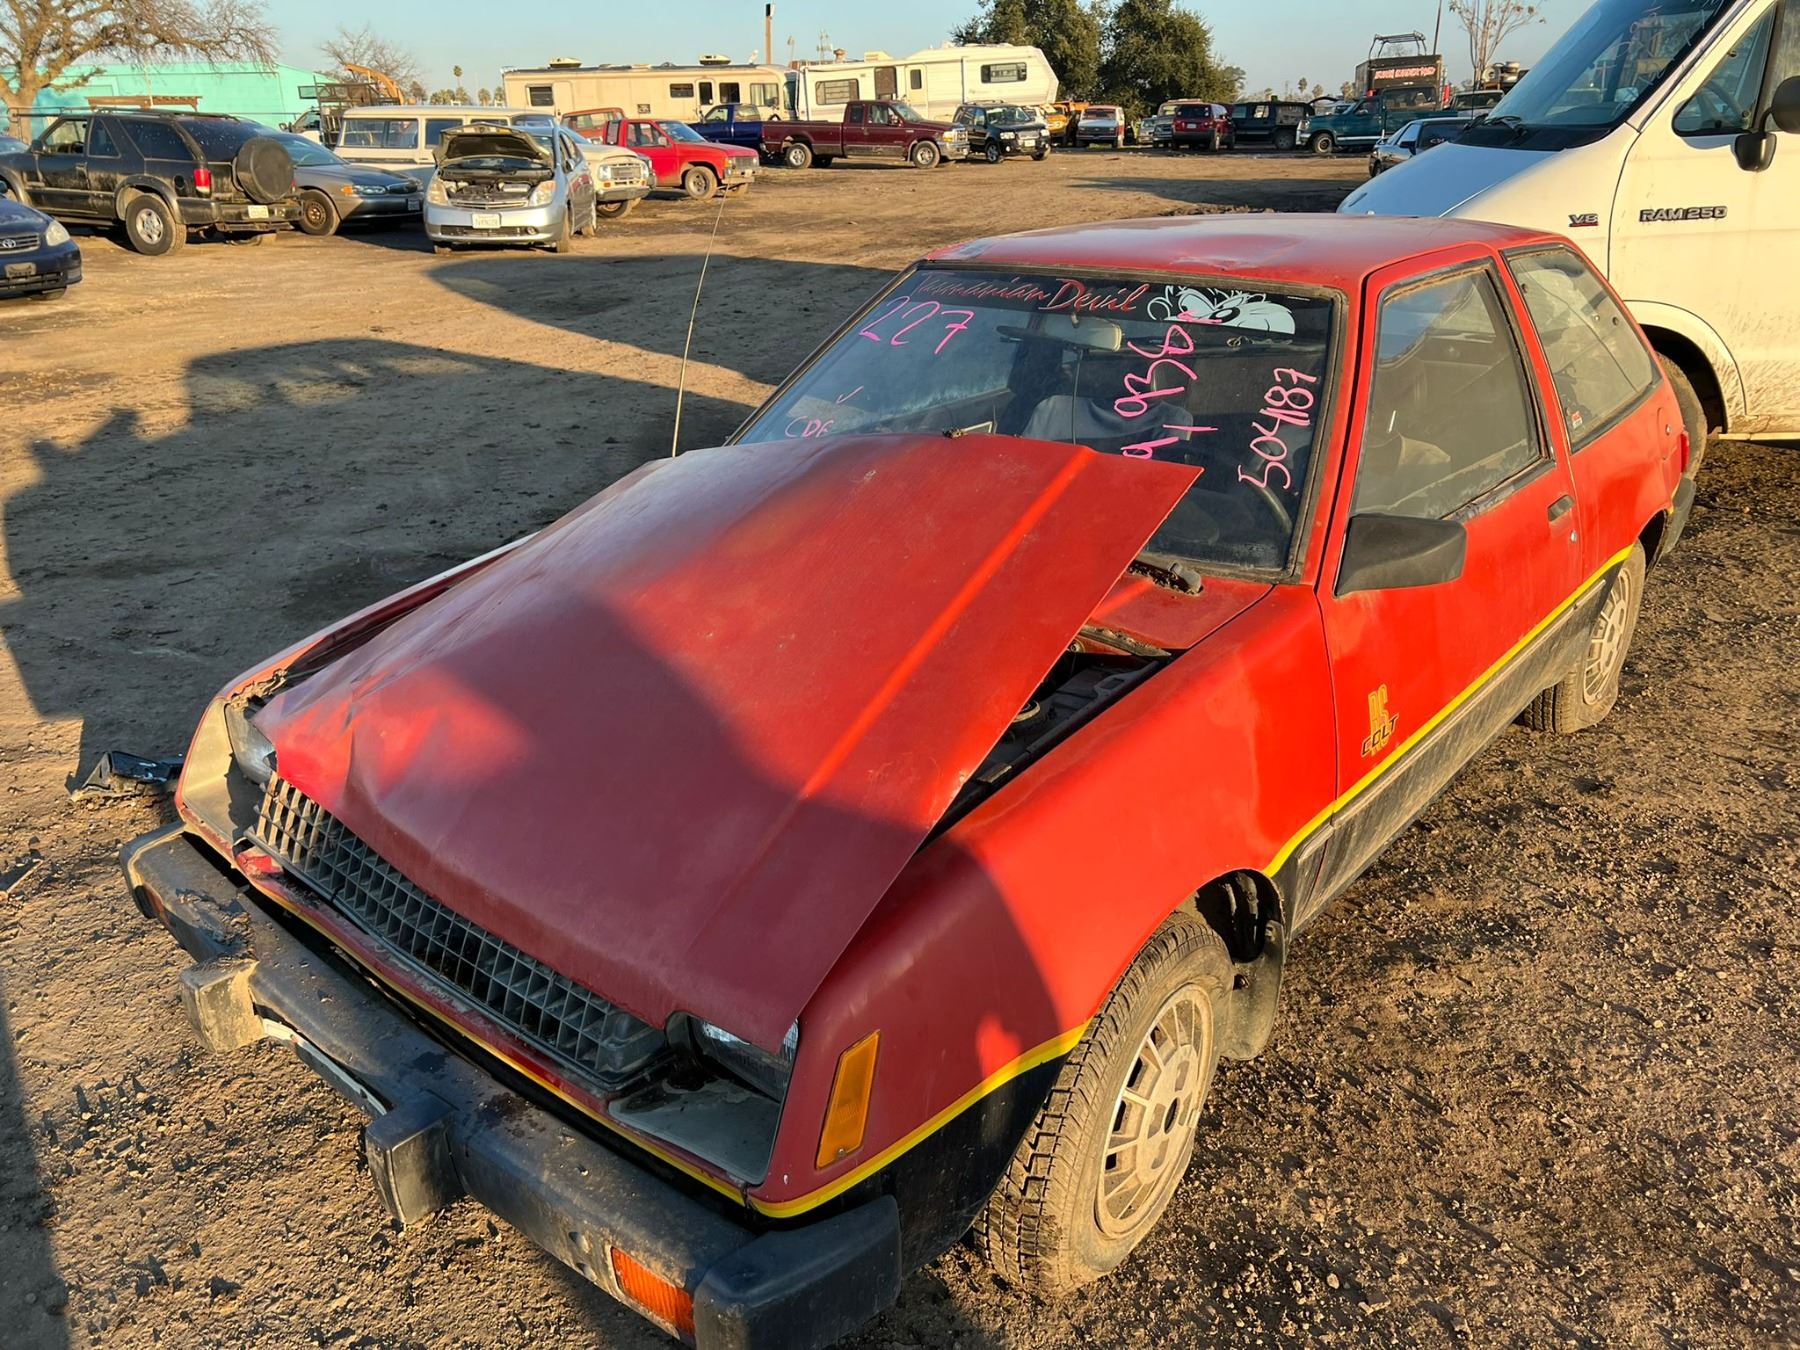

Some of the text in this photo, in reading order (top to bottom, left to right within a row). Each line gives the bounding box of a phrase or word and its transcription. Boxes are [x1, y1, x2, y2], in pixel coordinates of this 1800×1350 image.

[1569, 213, 1599, 227] V8
[1639, 206, 1728, 222] RAM 250
[1039, 278, 1150, 312] Devil
[858, 295, 975, 355] 227
[1361, 713, 1400, 758] COLT
